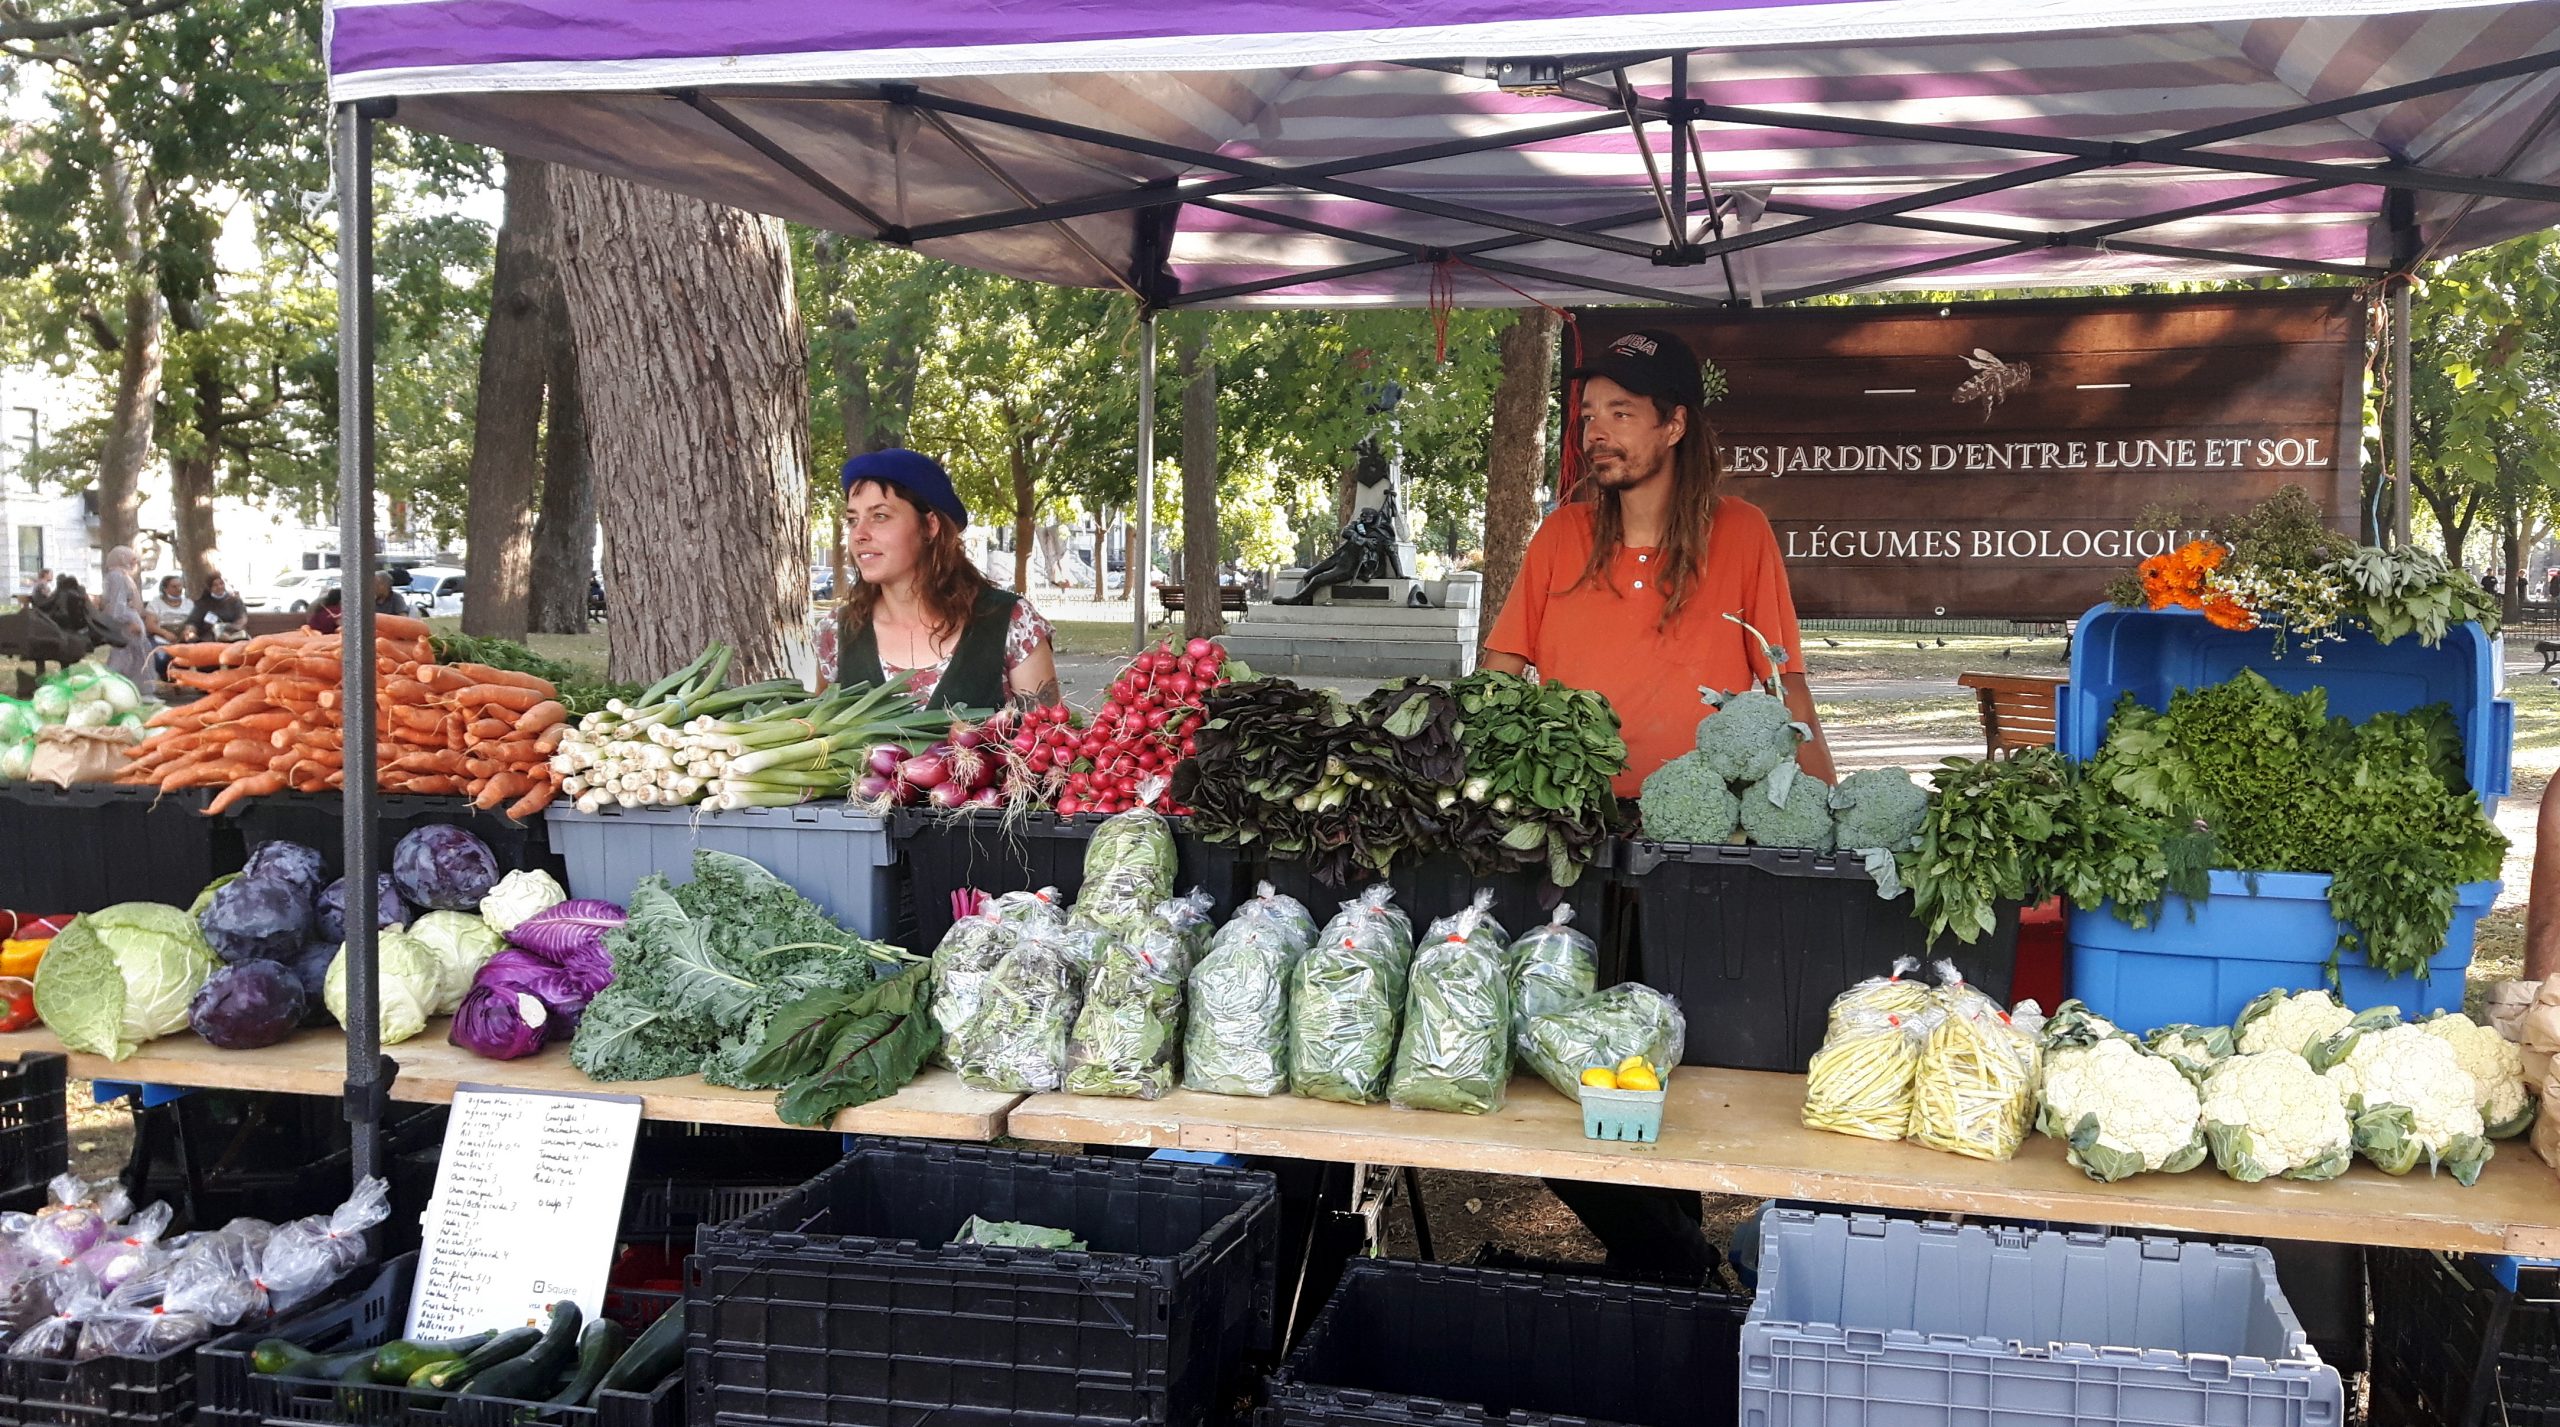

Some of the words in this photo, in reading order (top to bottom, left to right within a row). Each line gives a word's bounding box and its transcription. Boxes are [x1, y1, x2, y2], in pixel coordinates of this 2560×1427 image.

[1771, 445, 1922, 478] JARDINS
[1930, 441, 2088, 471] D'ENTRE
[2095, 439, 2197, 468] LUNE
[2205, 438, 2252, 468] ET
[2257, 438, 2329, 467] SOL
[1786, 524, 1961, 558] LÉGUMES
[547, 1283, 578, 1295] Square
